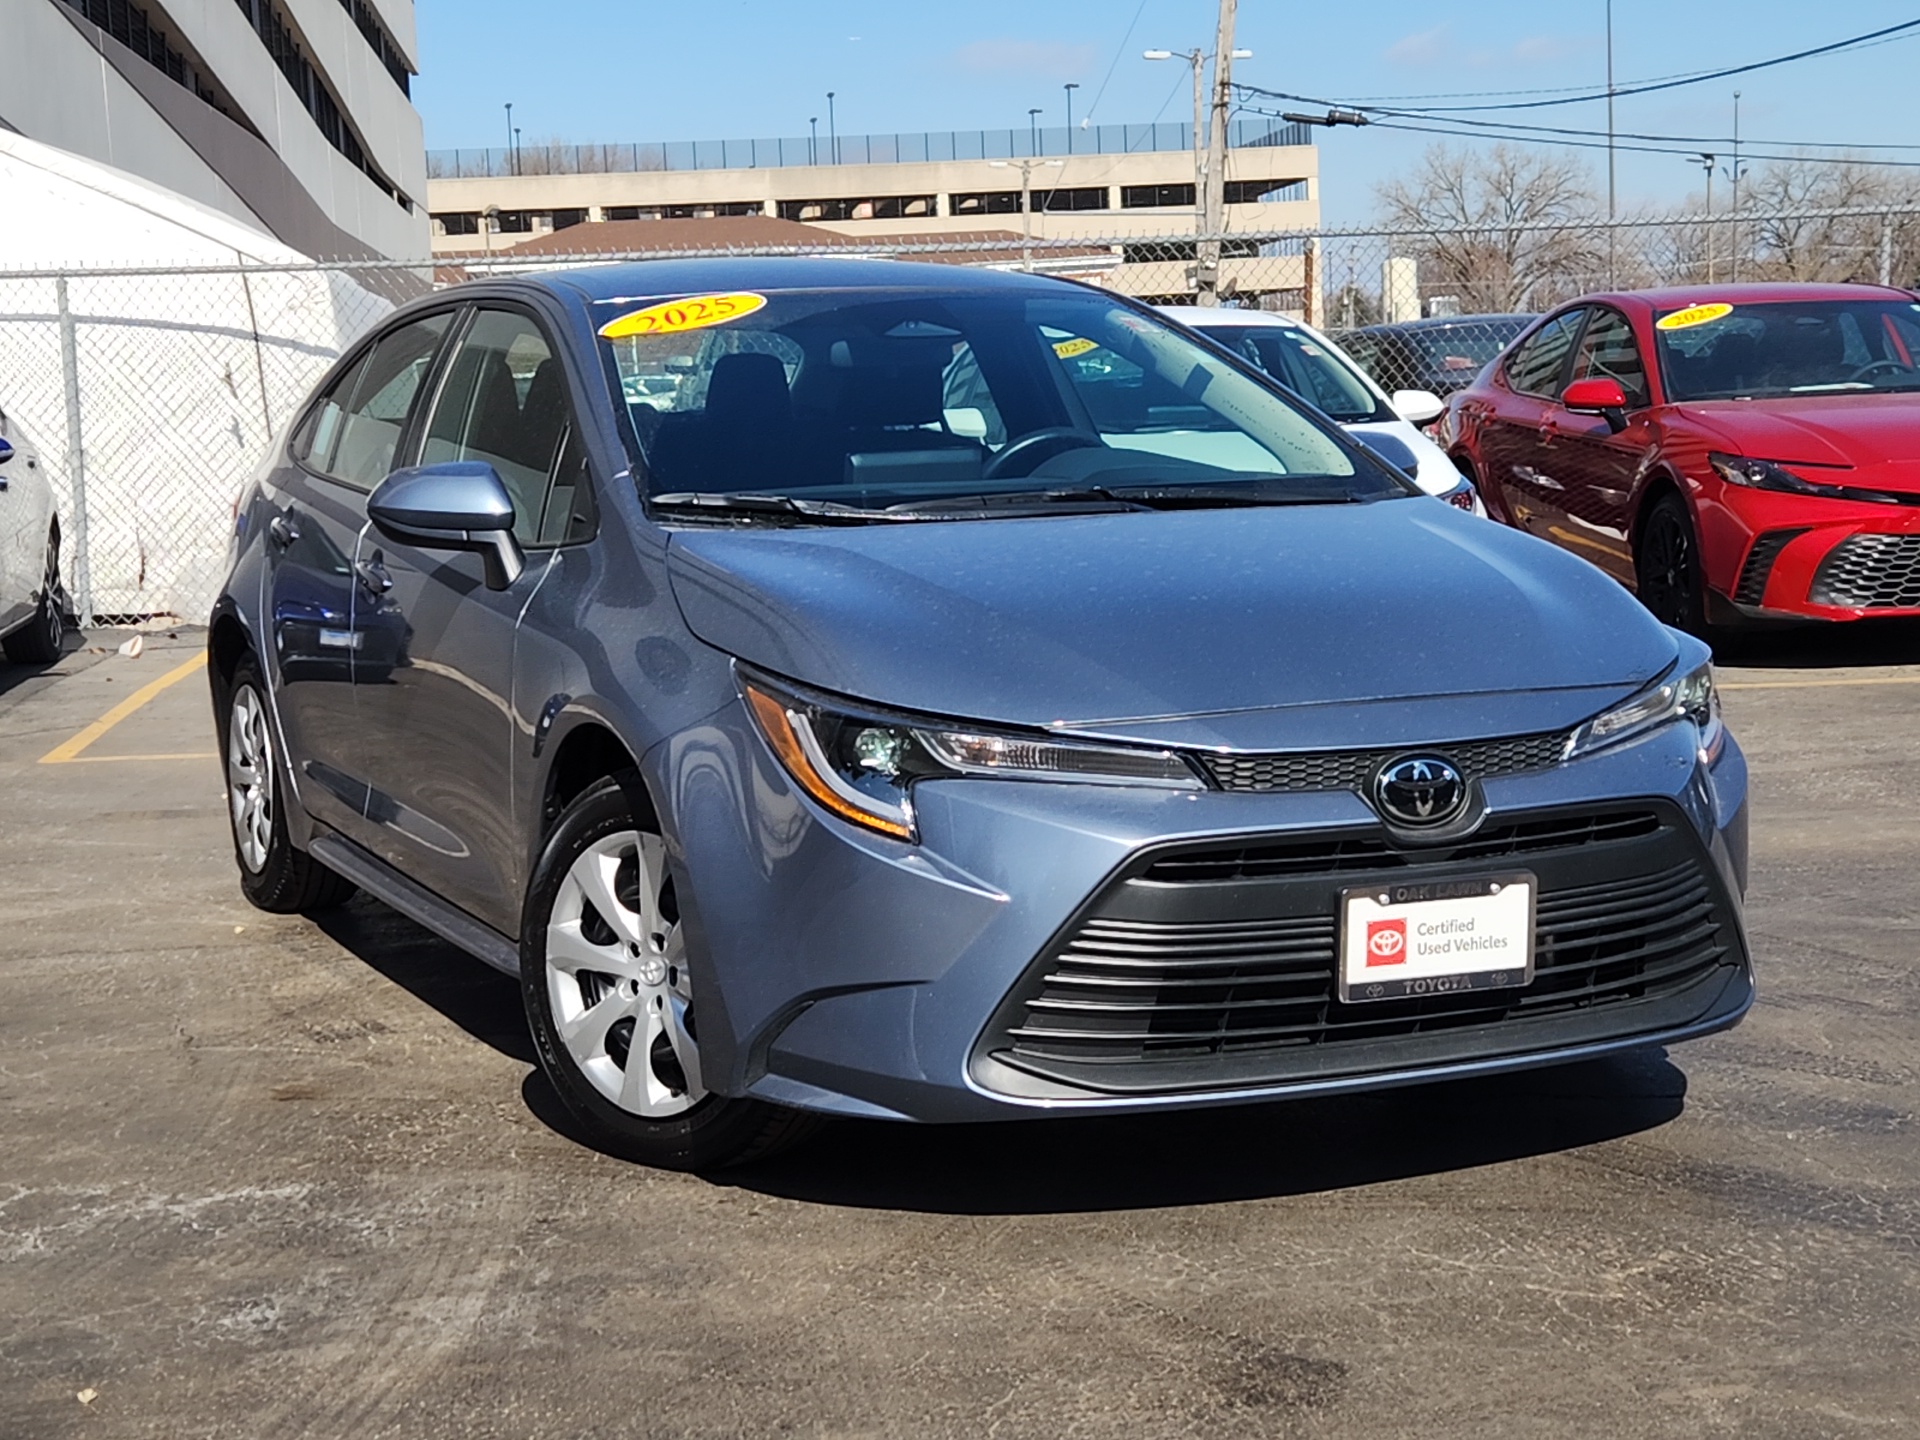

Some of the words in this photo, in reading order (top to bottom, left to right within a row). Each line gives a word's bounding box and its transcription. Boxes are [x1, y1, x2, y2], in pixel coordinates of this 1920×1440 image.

[637, 297, 736, 333] 2025
[1670, 306, 1717, 326] 2025
[1055, 340, 1092, 354] 025
[1396, 885, 1431, 901] OAK
[1435, 881, 1483, 898] LAWN
[1417, 917, 1475, 937] Certified
[1417, 939, 1451, 956] Used
[1453, 935, 1508, 953] Vehicles
[1403, 975, 1472, 995] TOYOTA
